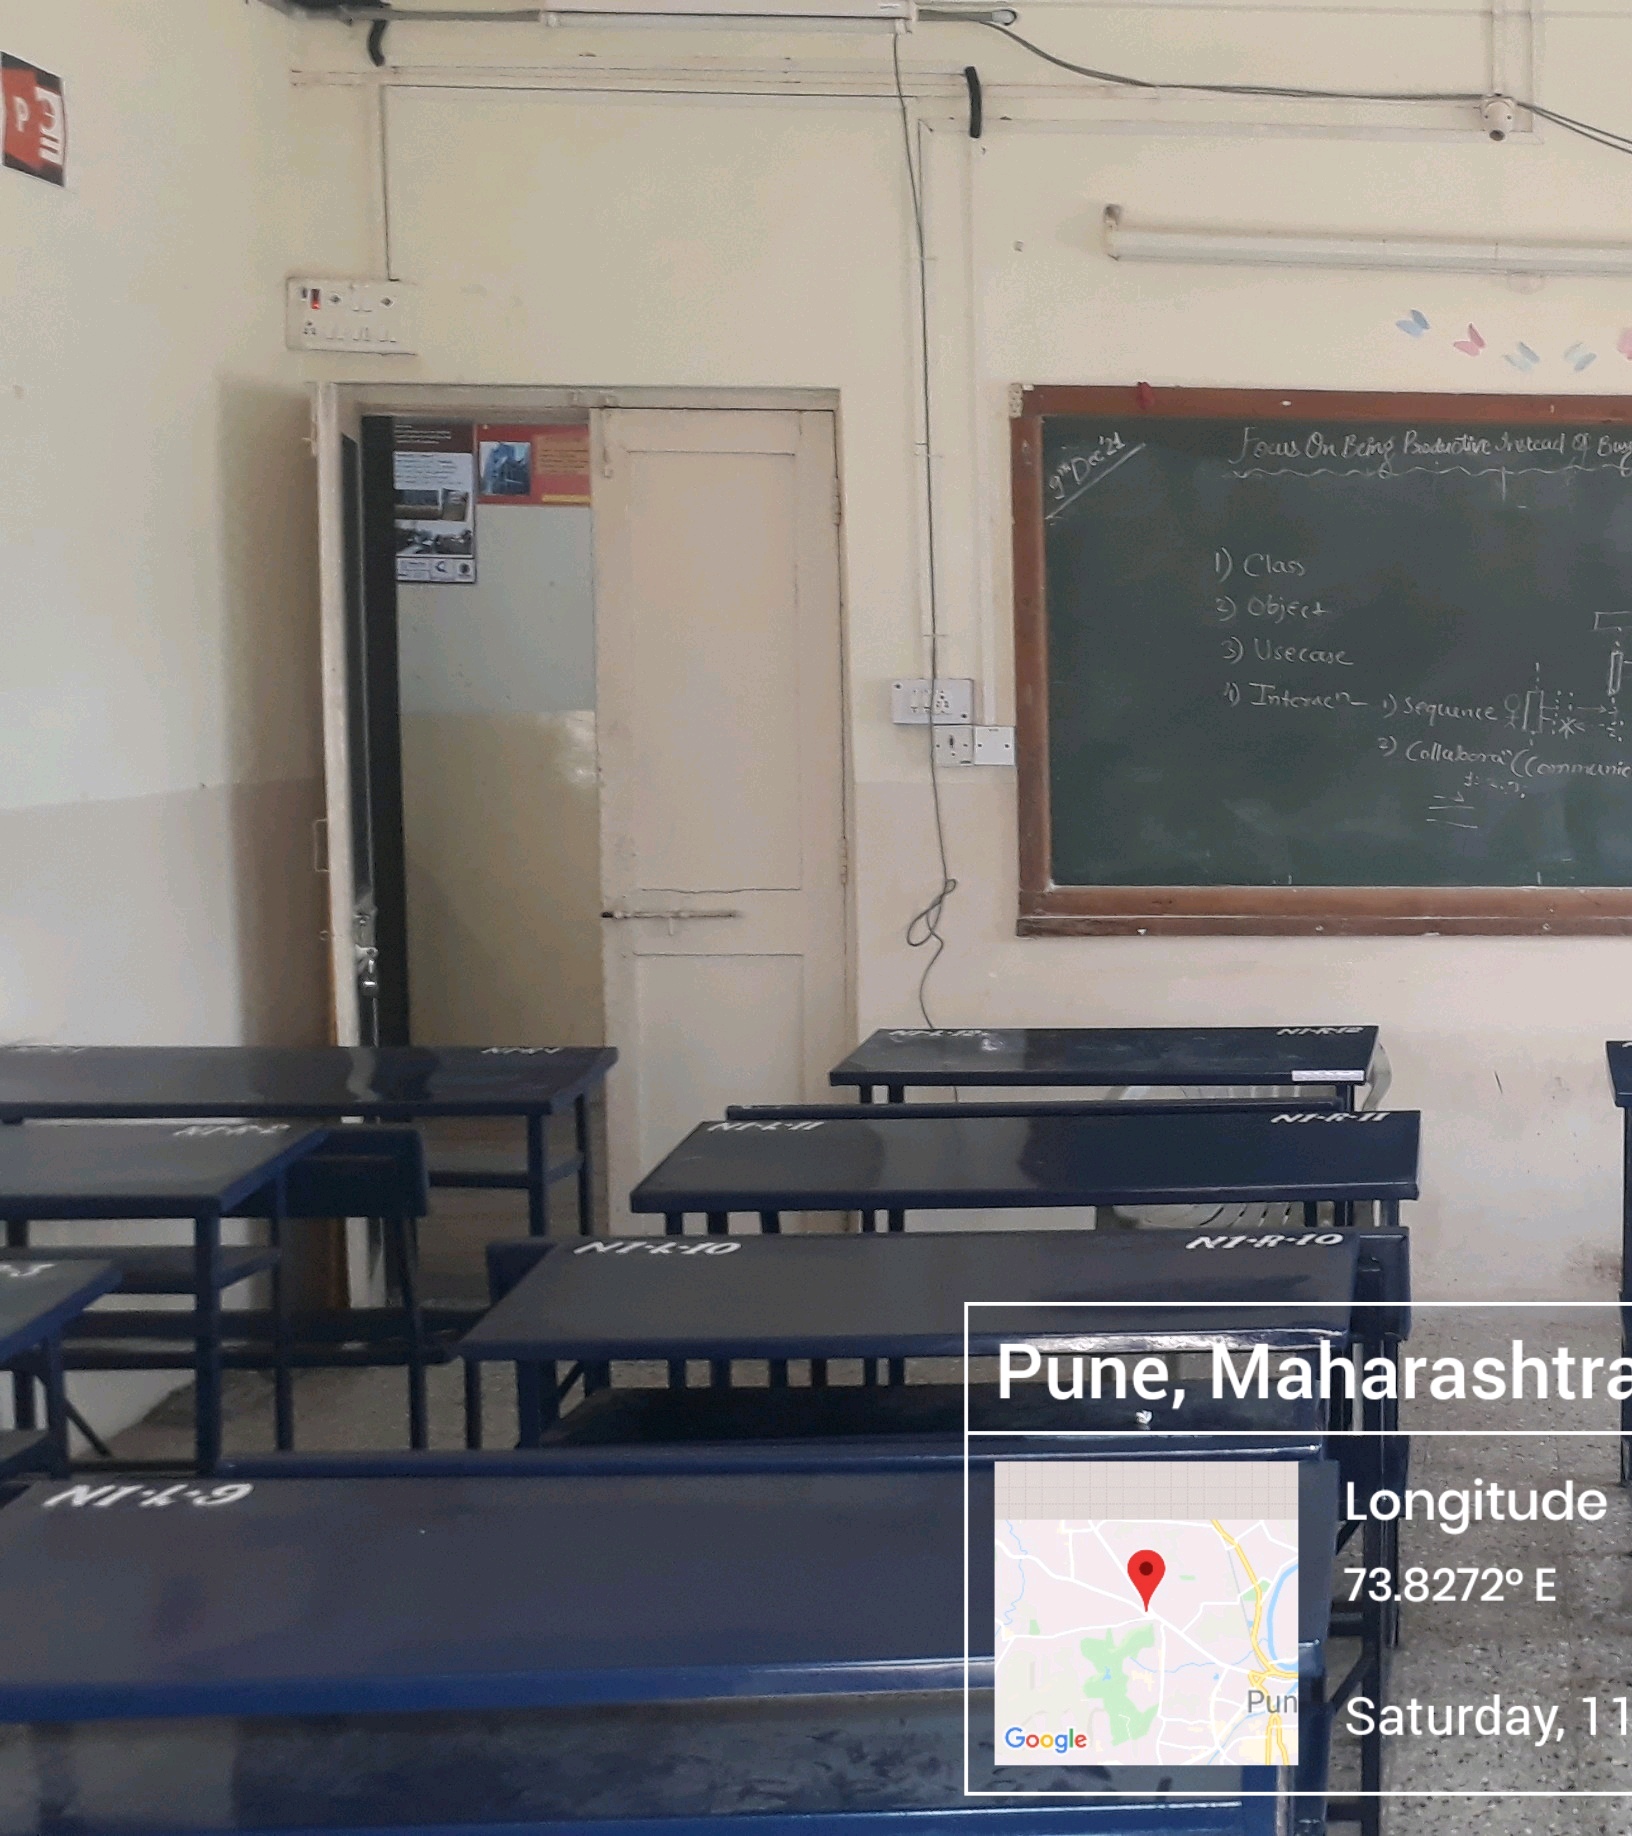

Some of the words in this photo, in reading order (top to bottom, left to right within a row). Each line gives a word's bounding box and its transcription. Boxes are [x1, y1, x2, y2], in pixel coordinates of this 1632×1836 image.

[1228, 426, 1301, 465] Focus
[1305, 431, 1338, 459] On
[1341, 433, 1396, 480] Being
[1403, 429, 1491, 456] Productive
[1495, 431, 1566, 454] Instead
[1215, 547, 1233, 583] 1)
[1243, 552, 1306, 577] Class
[1215, 595, 1237, 622] 2)
[1247, 593, 1328, 625] Object
[1220, 636, 1244, 666] 3)
[1253, 637, 1354, 666] Usecase
[1377, 735, 1398, 757] 2)
